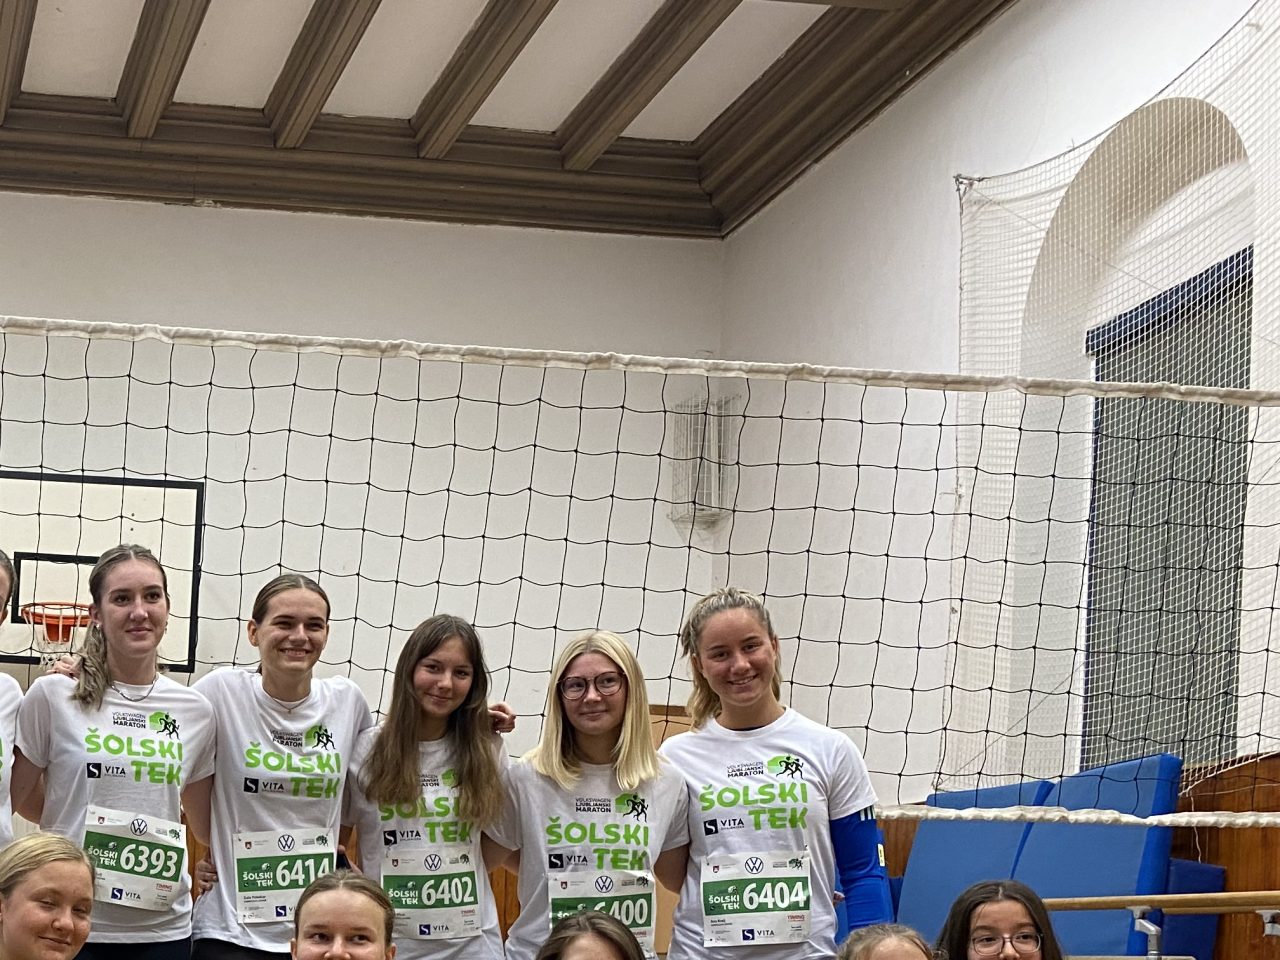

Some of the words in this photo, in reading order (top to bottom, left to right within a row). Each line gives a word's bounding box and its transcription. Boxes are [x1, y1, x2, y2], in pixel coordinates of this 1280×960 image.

[113, 720, 146, 729] MARATON
[85, 727, 183, 762] ŠOLSKI
[244, 741, 341, 773] ŠOLSKI
[105, 765, 126, 775] VITA
[131, 760, 182, 786] TEK
[728, 770, 764, 778] MARATON
[262, 781, 284, 790] VITA
[290, 777, 340, 798] TEK
[699, 782, 808, 811] ŠOLSKI
[721, 818, 744, 826] VITA
[748, 806, 808, 830] TEK
[400, 830, 421, 838] VITA
[425, 821, 473, 843] TEK
[546, 816, 649, 847] ŠOLSKI
[88, 846, 118, 859] ŠOLSKI
[99, 857, 117, 866] TEK
[120, 844, 178, 878] 6393
[566, 855, 588, 863] VITA
[593, 848, 648, 870] TEK
[243, 872, 273, 880] ŠOLSKI
[276, 858, 330, 886] 6414
[388, 889, 418, 897] ŠOLSKI
[421, 877, 474, 905] 6402
[708, 894, 739, 904] ŠOLSKI
[743, 882, 806, 910] 6404
